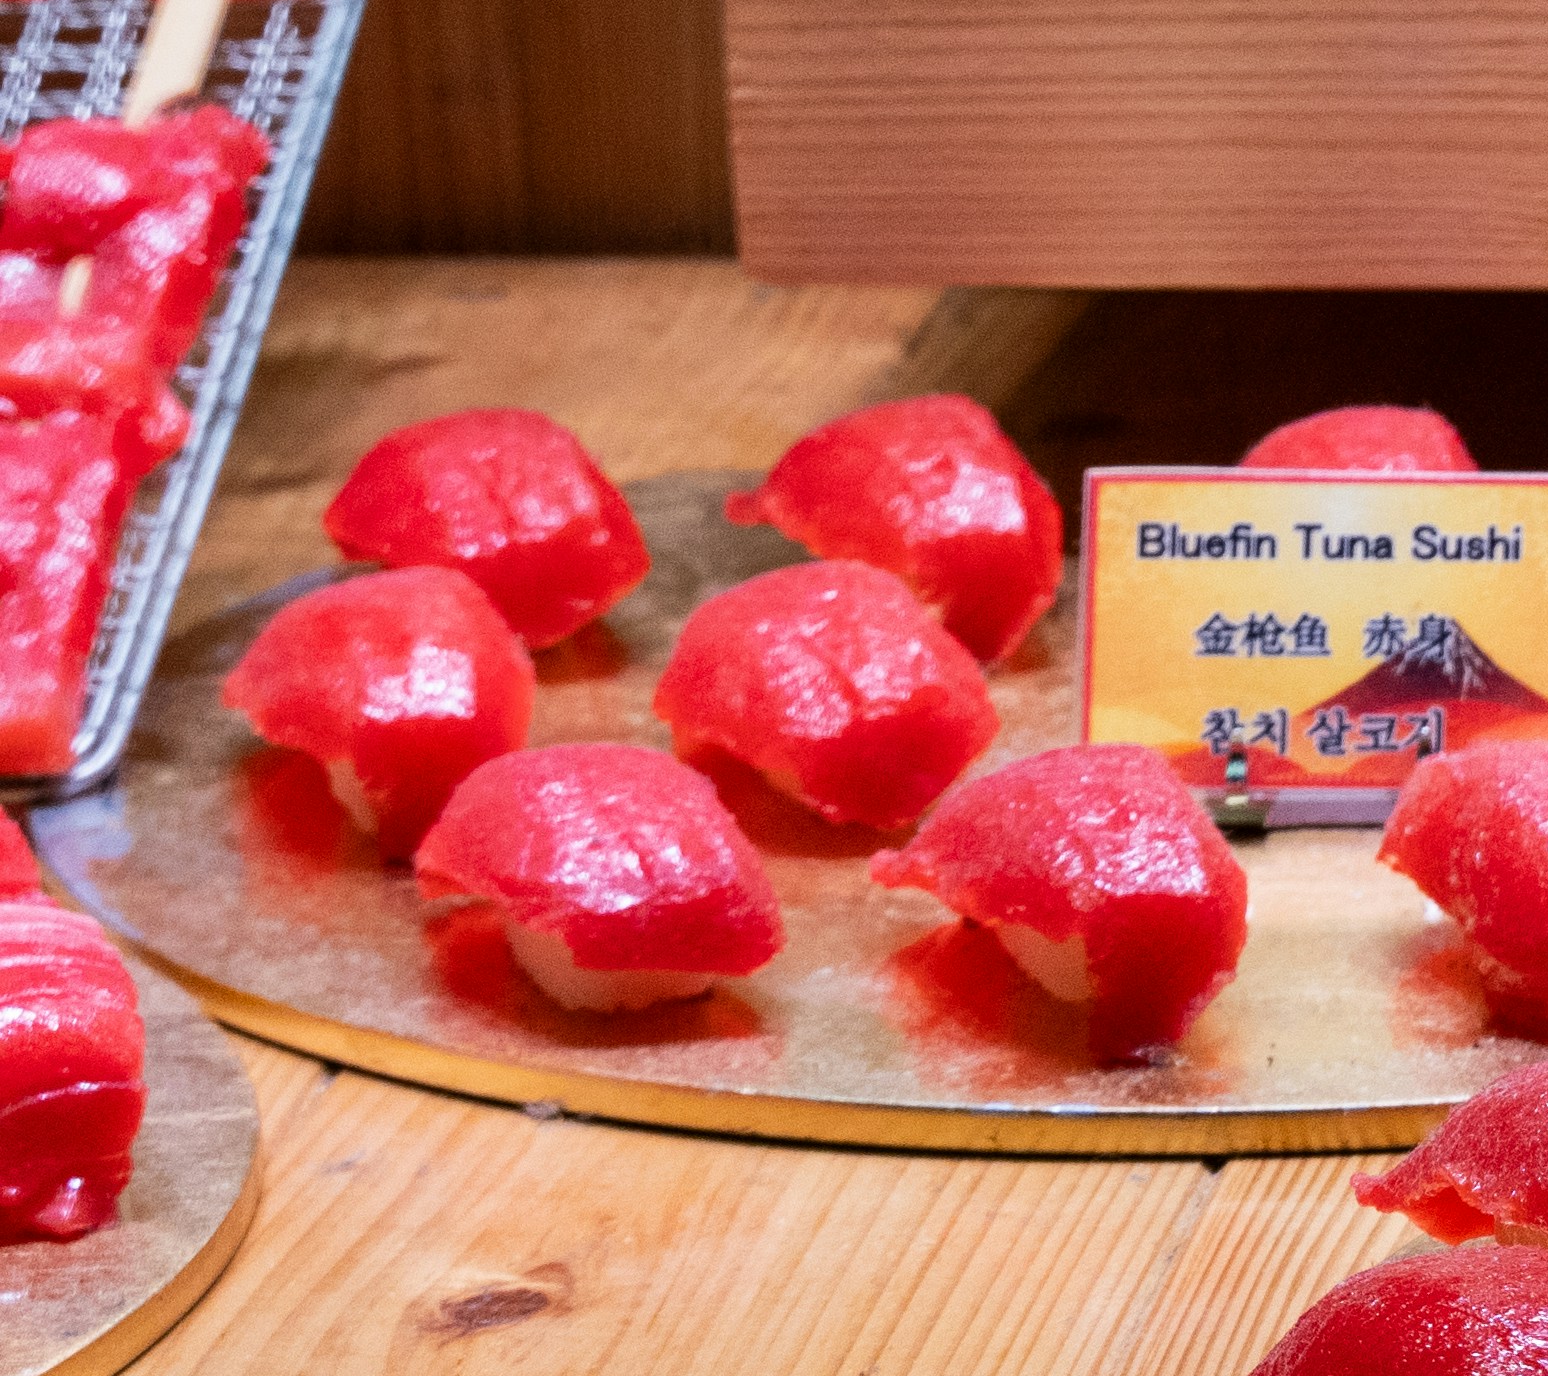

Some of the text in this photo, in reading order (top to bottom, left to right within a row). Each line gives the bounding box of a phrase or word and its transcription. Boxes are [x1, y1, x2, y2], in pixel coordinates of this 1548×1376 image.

[1138, 523, 1521, 562] Bluefin Tuna Sushi
[1195, 613, 1454, 659] 金枪鱼 赤身
